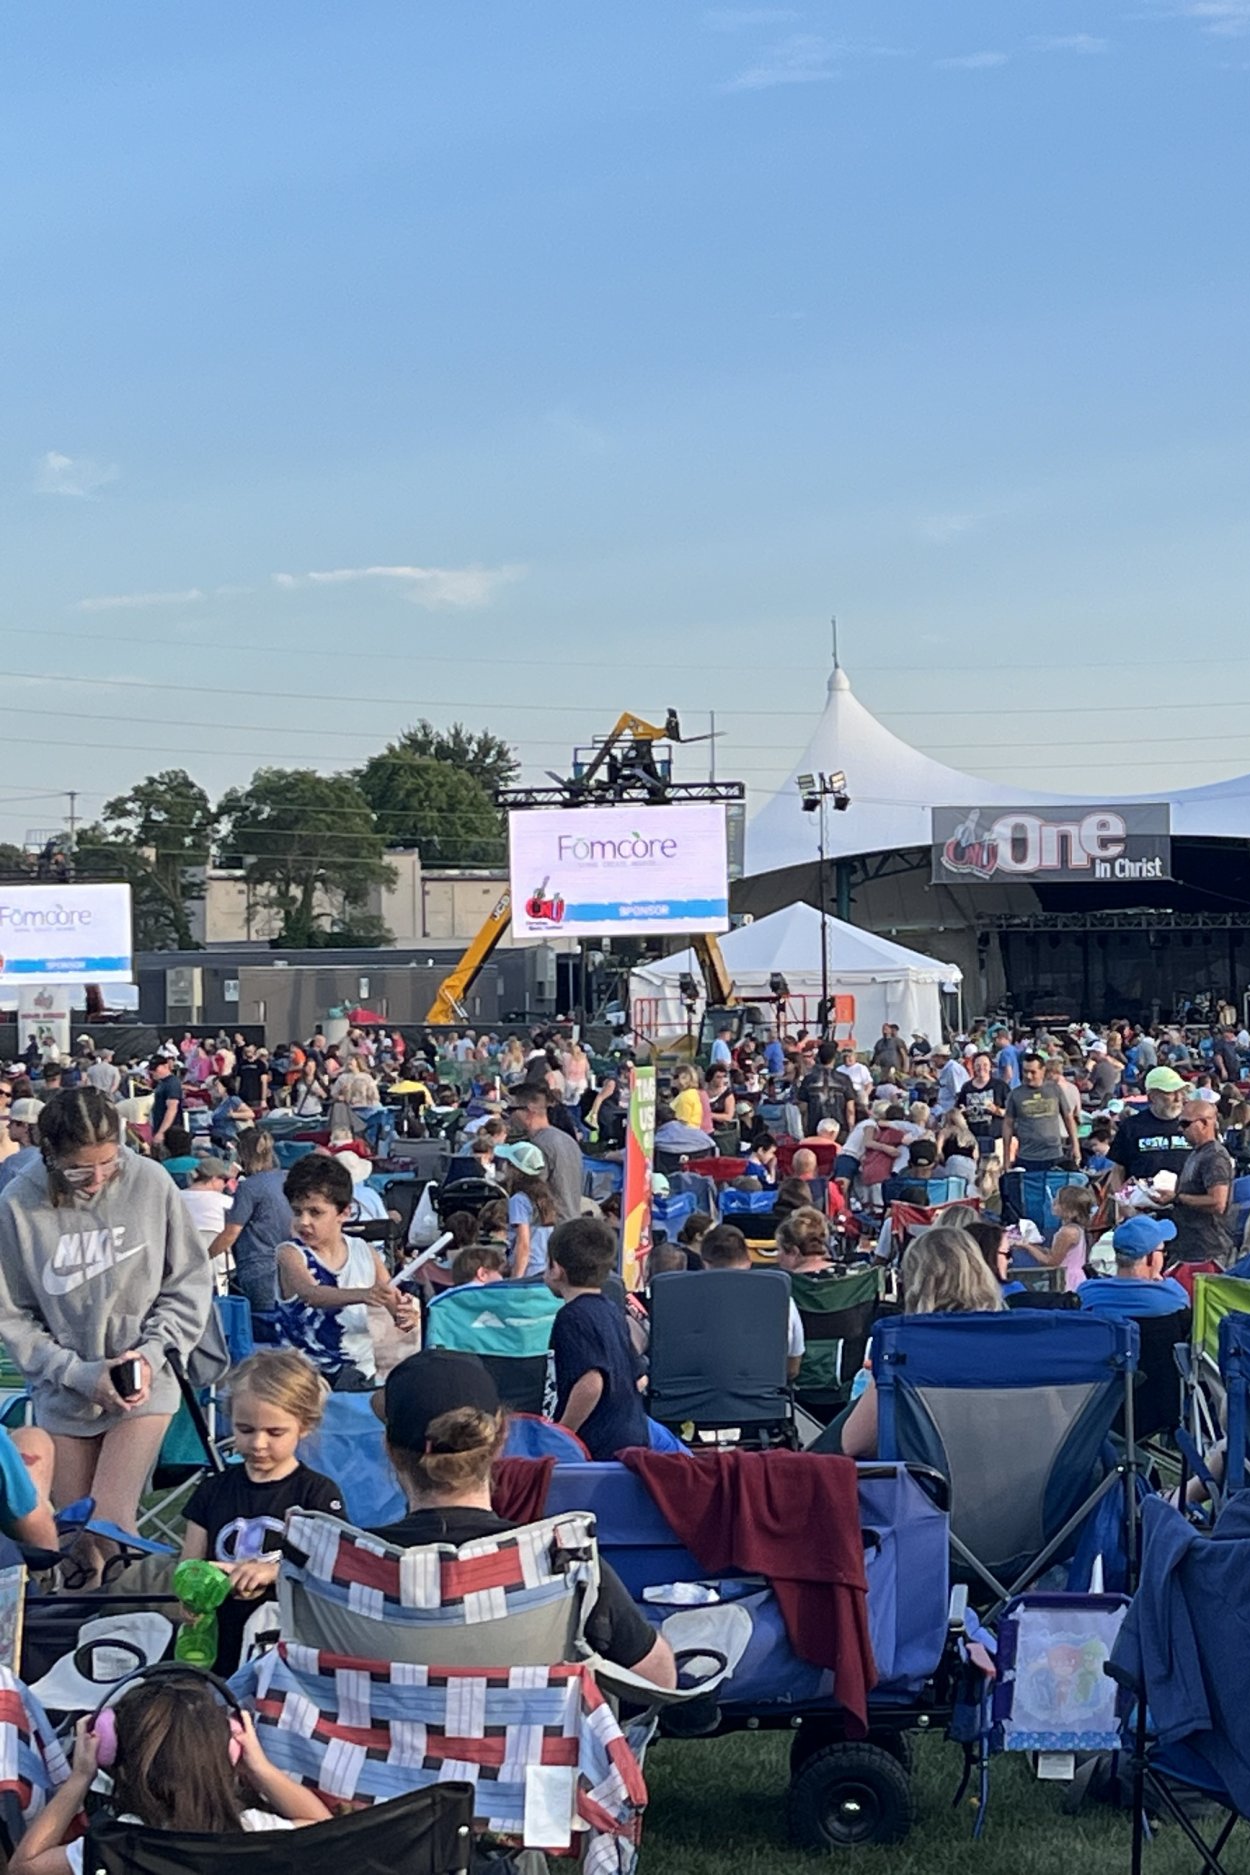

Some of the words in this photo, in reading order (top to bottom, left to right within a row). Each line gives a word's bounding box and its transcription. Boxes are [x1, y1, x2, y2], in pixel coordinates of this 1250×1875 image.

[992, 811, 1127, 874] One
[1095, 859, 1111, 878] in
[1114, 857, 1162, 878] Christ
[619, 904, 670, 917] SPONSOR
[54, 1226, 126, 1268] NIKE
